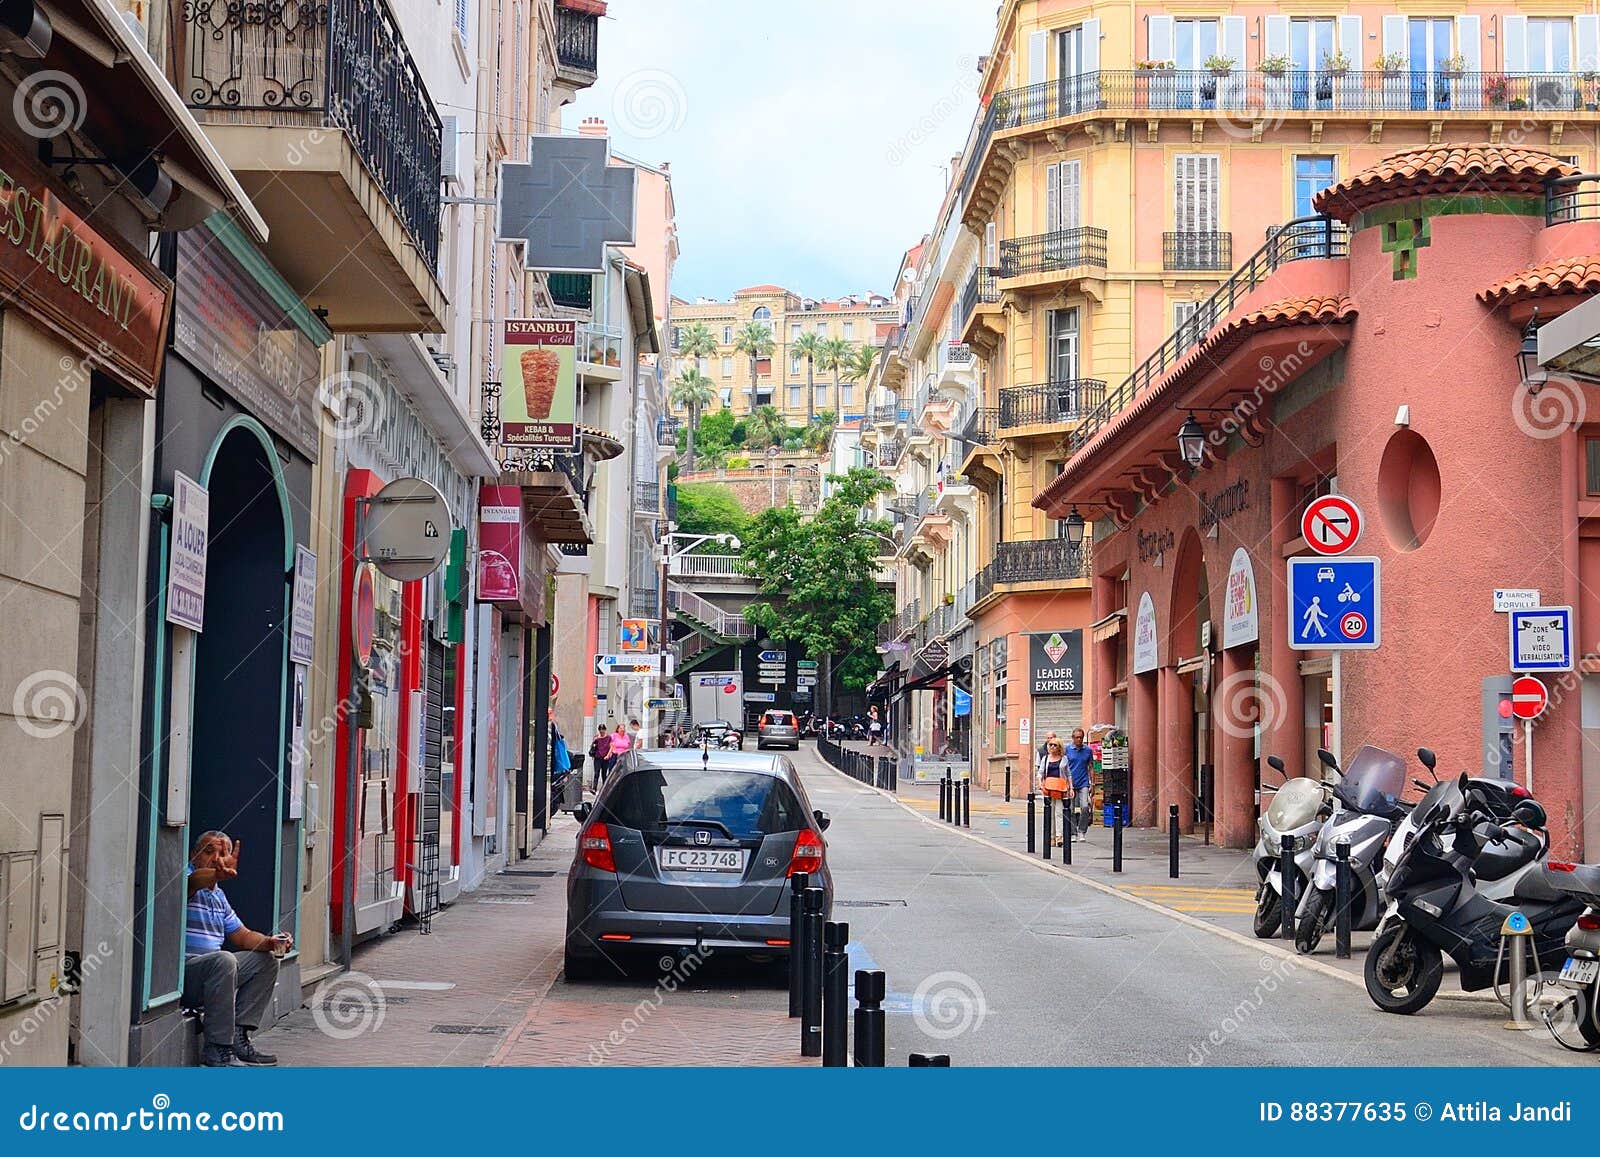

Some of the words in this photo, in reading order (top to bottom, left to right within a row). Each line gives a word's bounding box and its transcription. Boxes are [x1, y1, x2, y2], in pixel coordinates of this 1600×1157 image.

[507, 322, 574, 334] ISTANBUL
[550, 335, 572, 344] Grill
[524, 425, 547, 434] KEBAB
[548, 425, 554, 434] &
[507, 434, 543, 443] Spécialités
[544, 434, 571, 443] Turques
[184, 521, 205, 557] LOUER
[1346, 621, 1361, 630] 20
[1520, 653, 1563, 661] VERBALISATION
[1036, 668, 1073, 679] LEADER
[1035, 680, 1075, 691] EXPRESS
[668, 853, 690, 866] FC
[693, 853, 707, 866] 23
[711, 853, 737, 867] 748
